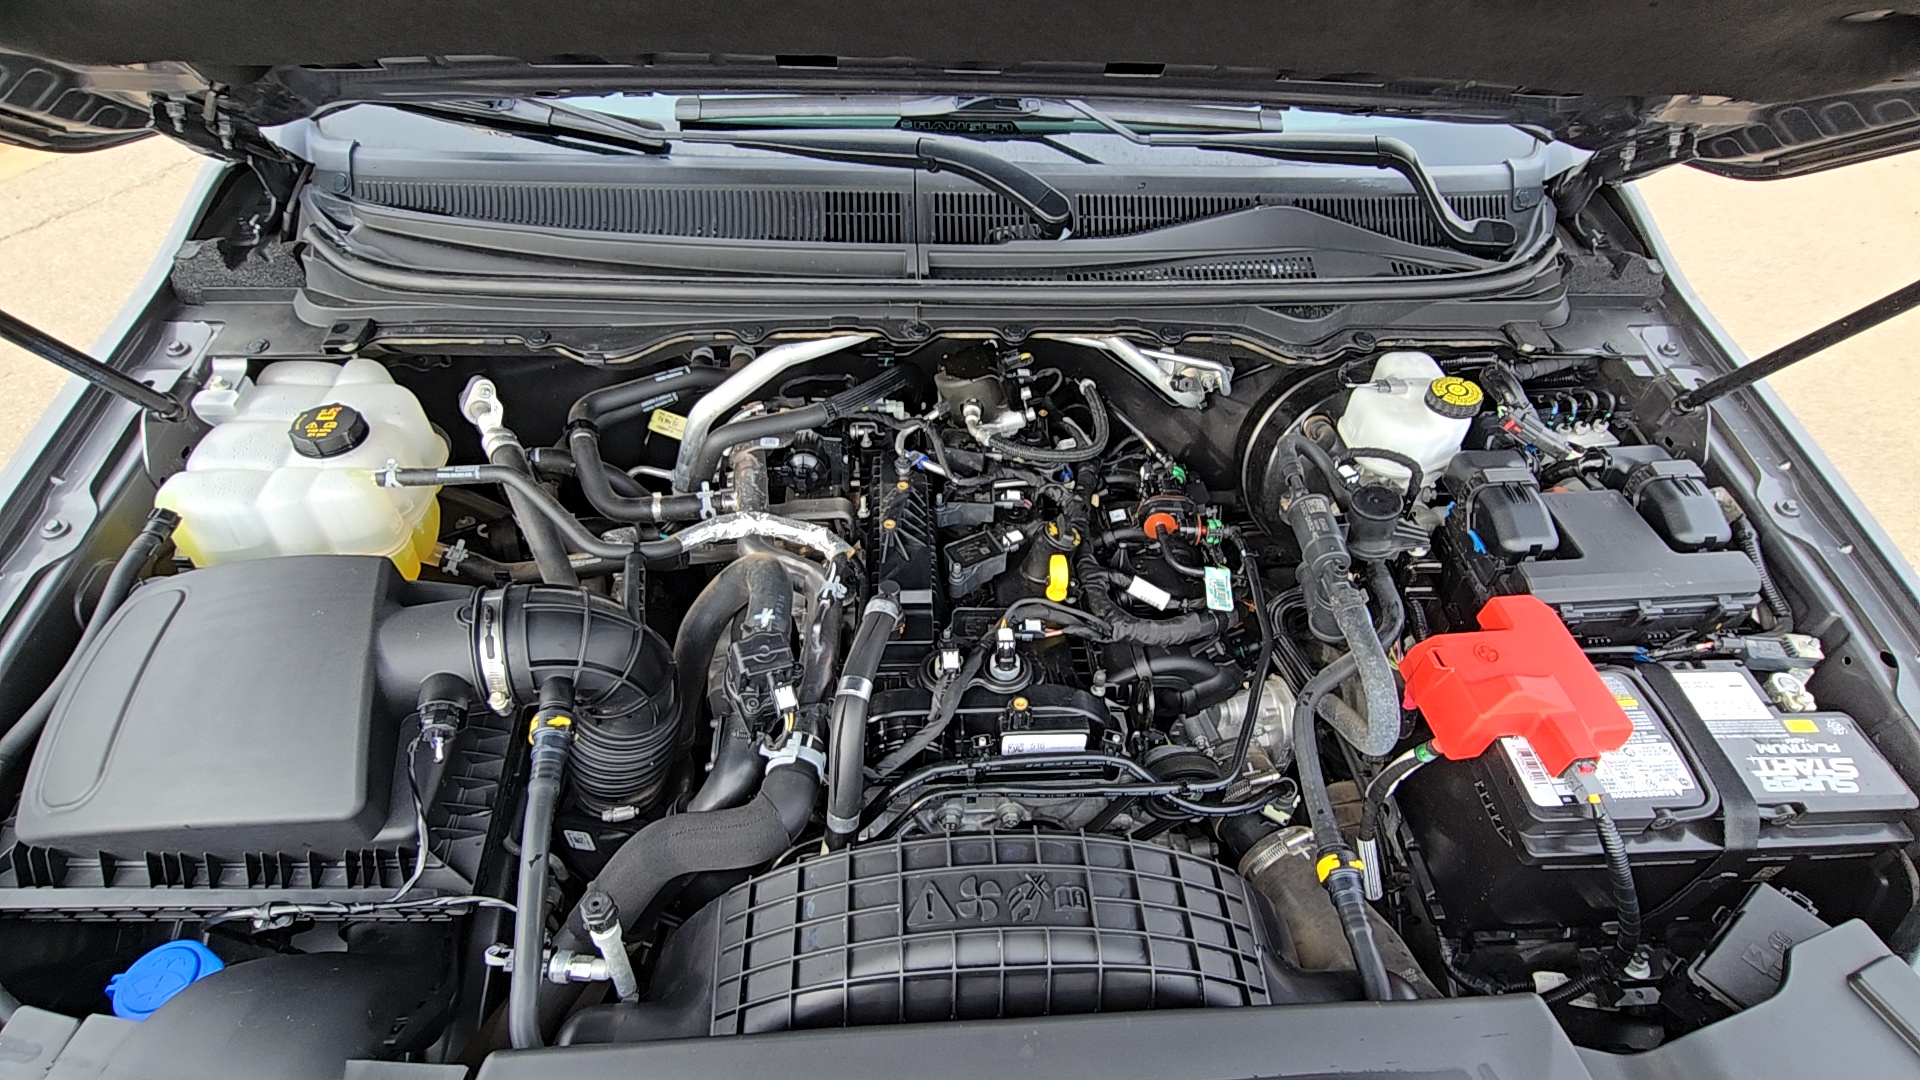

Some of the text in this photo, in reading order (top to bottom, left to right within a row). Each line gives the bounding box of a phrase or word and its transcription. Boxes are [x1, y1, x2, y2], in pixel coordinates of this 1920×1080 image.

[1755, 743, 1841, 754] PLATINUM
[1751, 757, 1859, 778] START
[1759, 775, 1860, 794] SUPER
